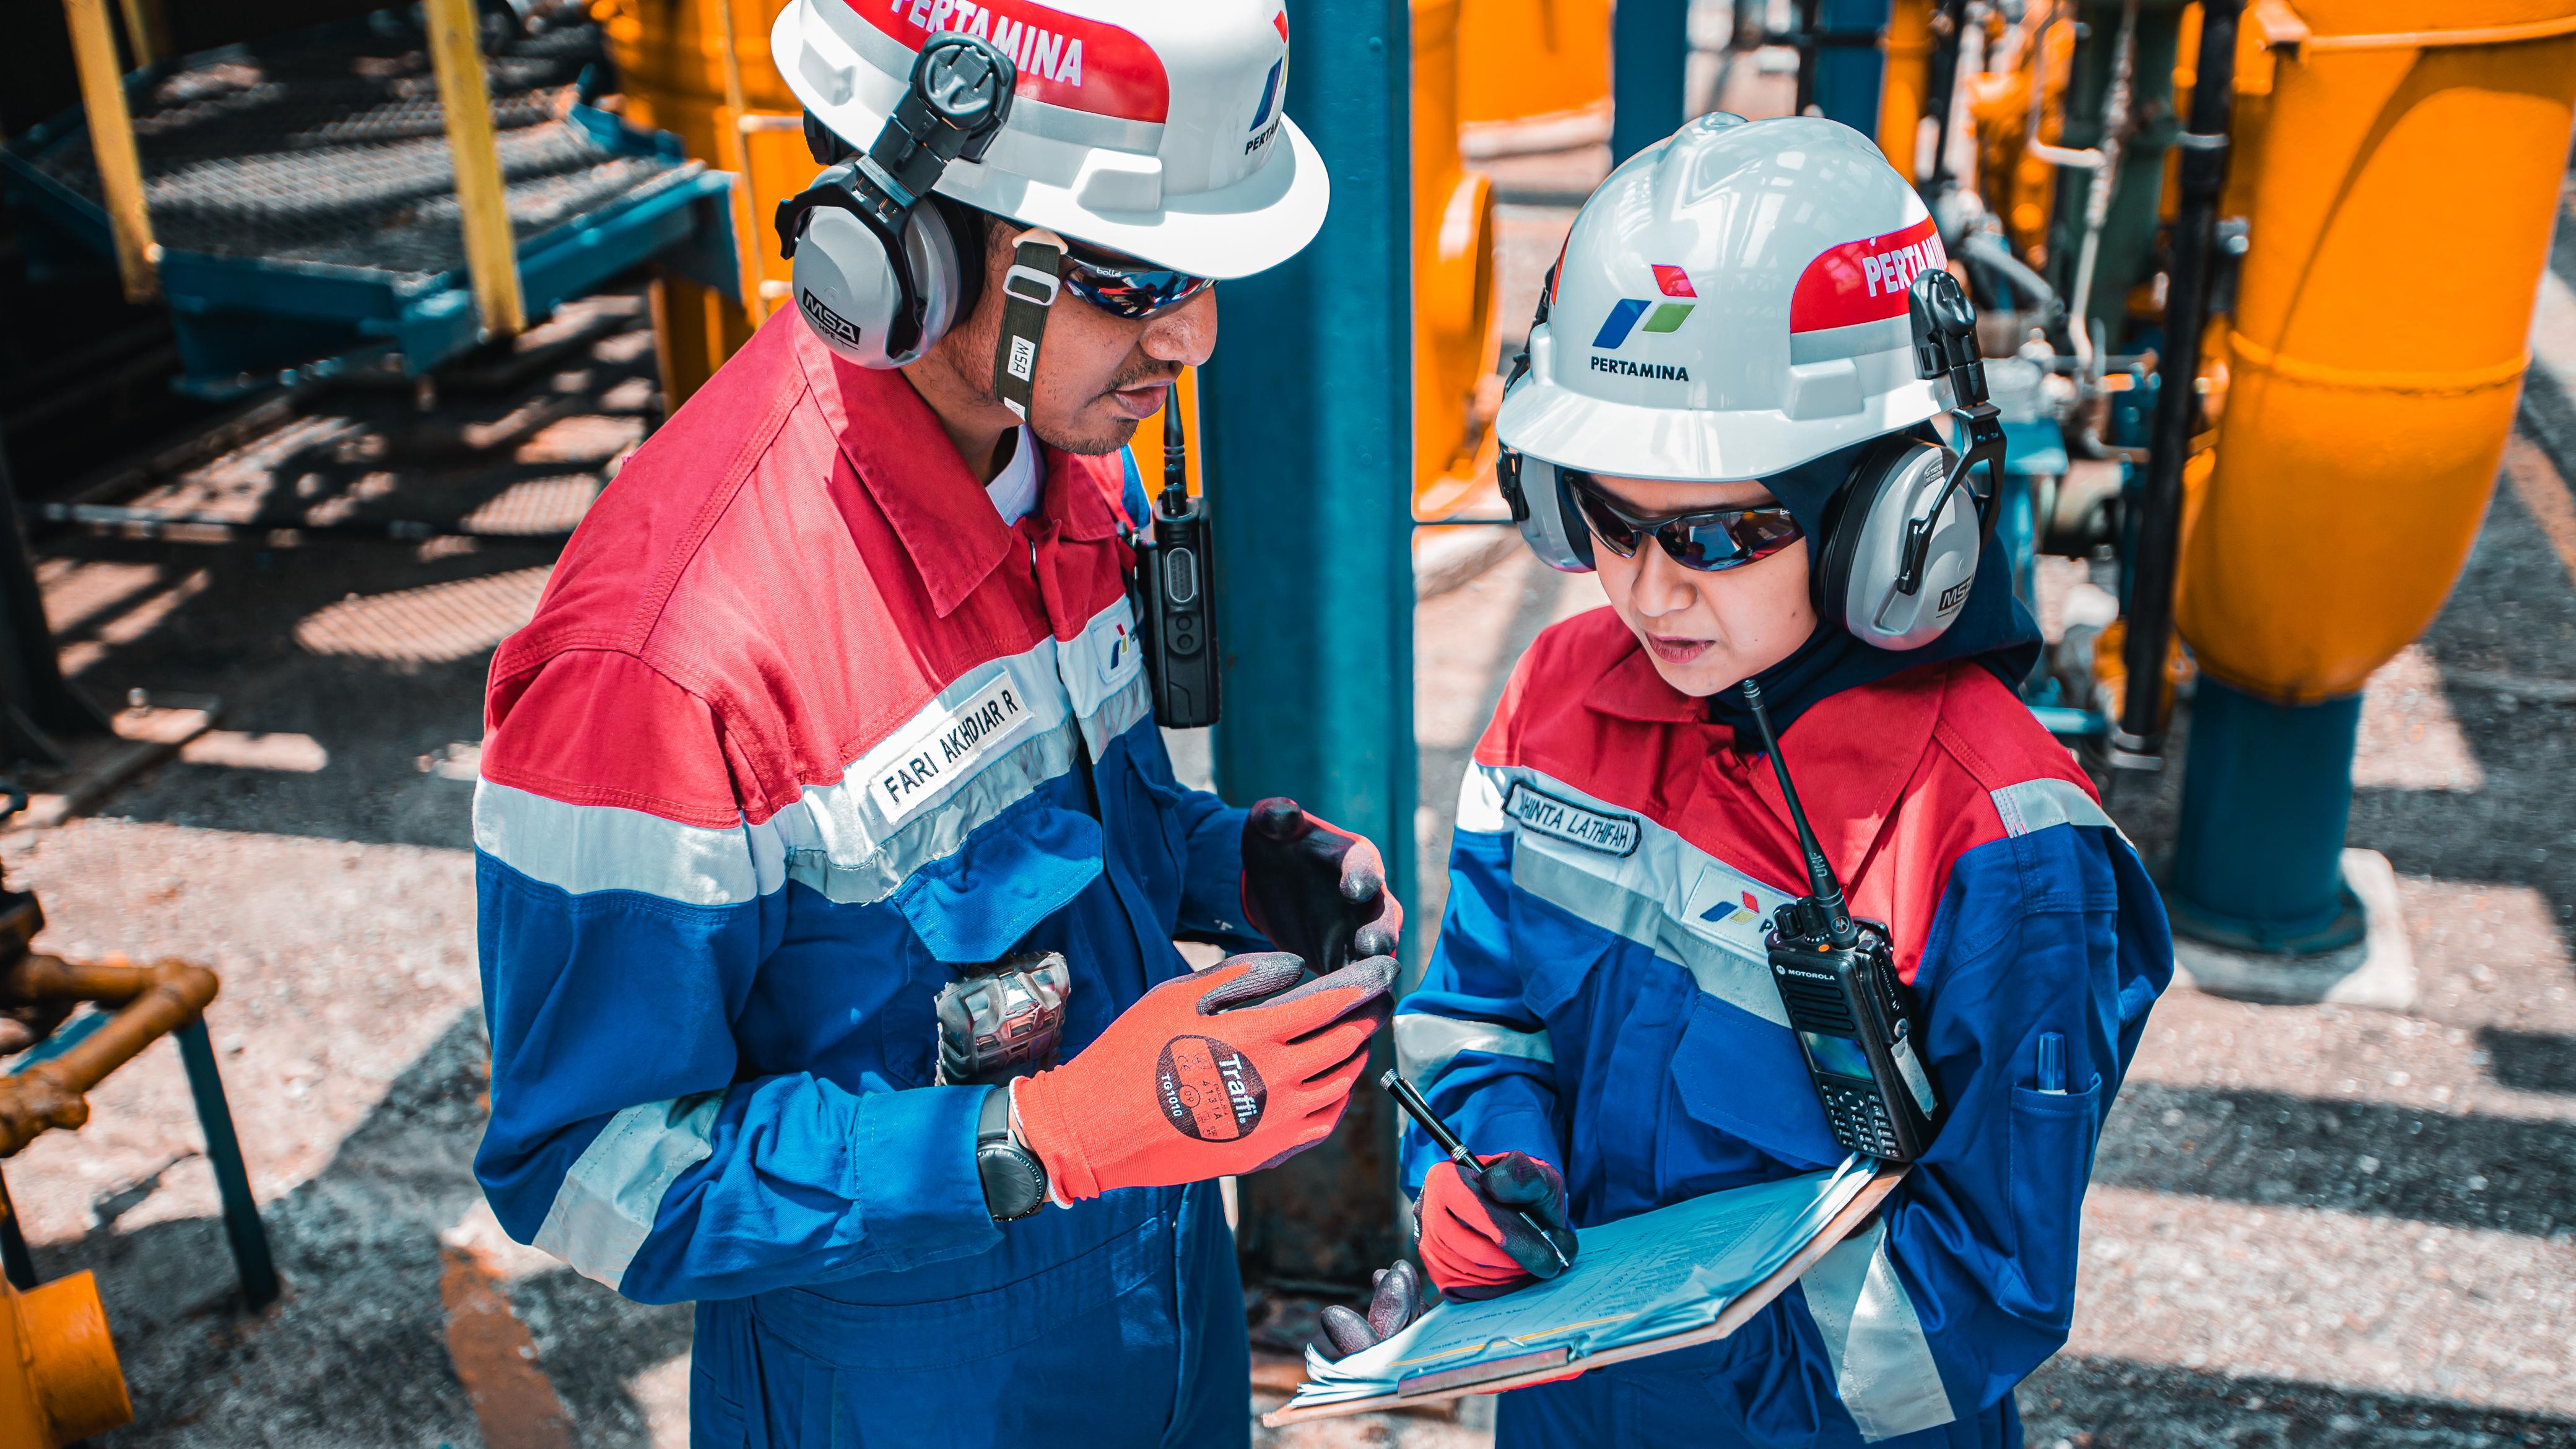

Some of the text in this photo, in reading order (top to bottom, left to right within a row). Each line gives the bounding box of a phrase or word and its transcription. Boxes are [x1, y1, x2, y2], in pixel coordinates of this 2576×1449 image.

[805, 294, 856, 342] MSA
[818, 323, 836, 340] HPE
[1012, 342, 1029, 374] MSA
[1591, 356, 1689, 381] PERTAMINA
[884, 689, 1019, 804] FARI AKHDIAR R
[1567, 813, 1629, 848] LATHIFAH
[1808, 851, 1828, 877] UHF
[1788, 969, 1835, 981] MOTOROLA
[1161, 1073, 1183, 1116] TG1010
